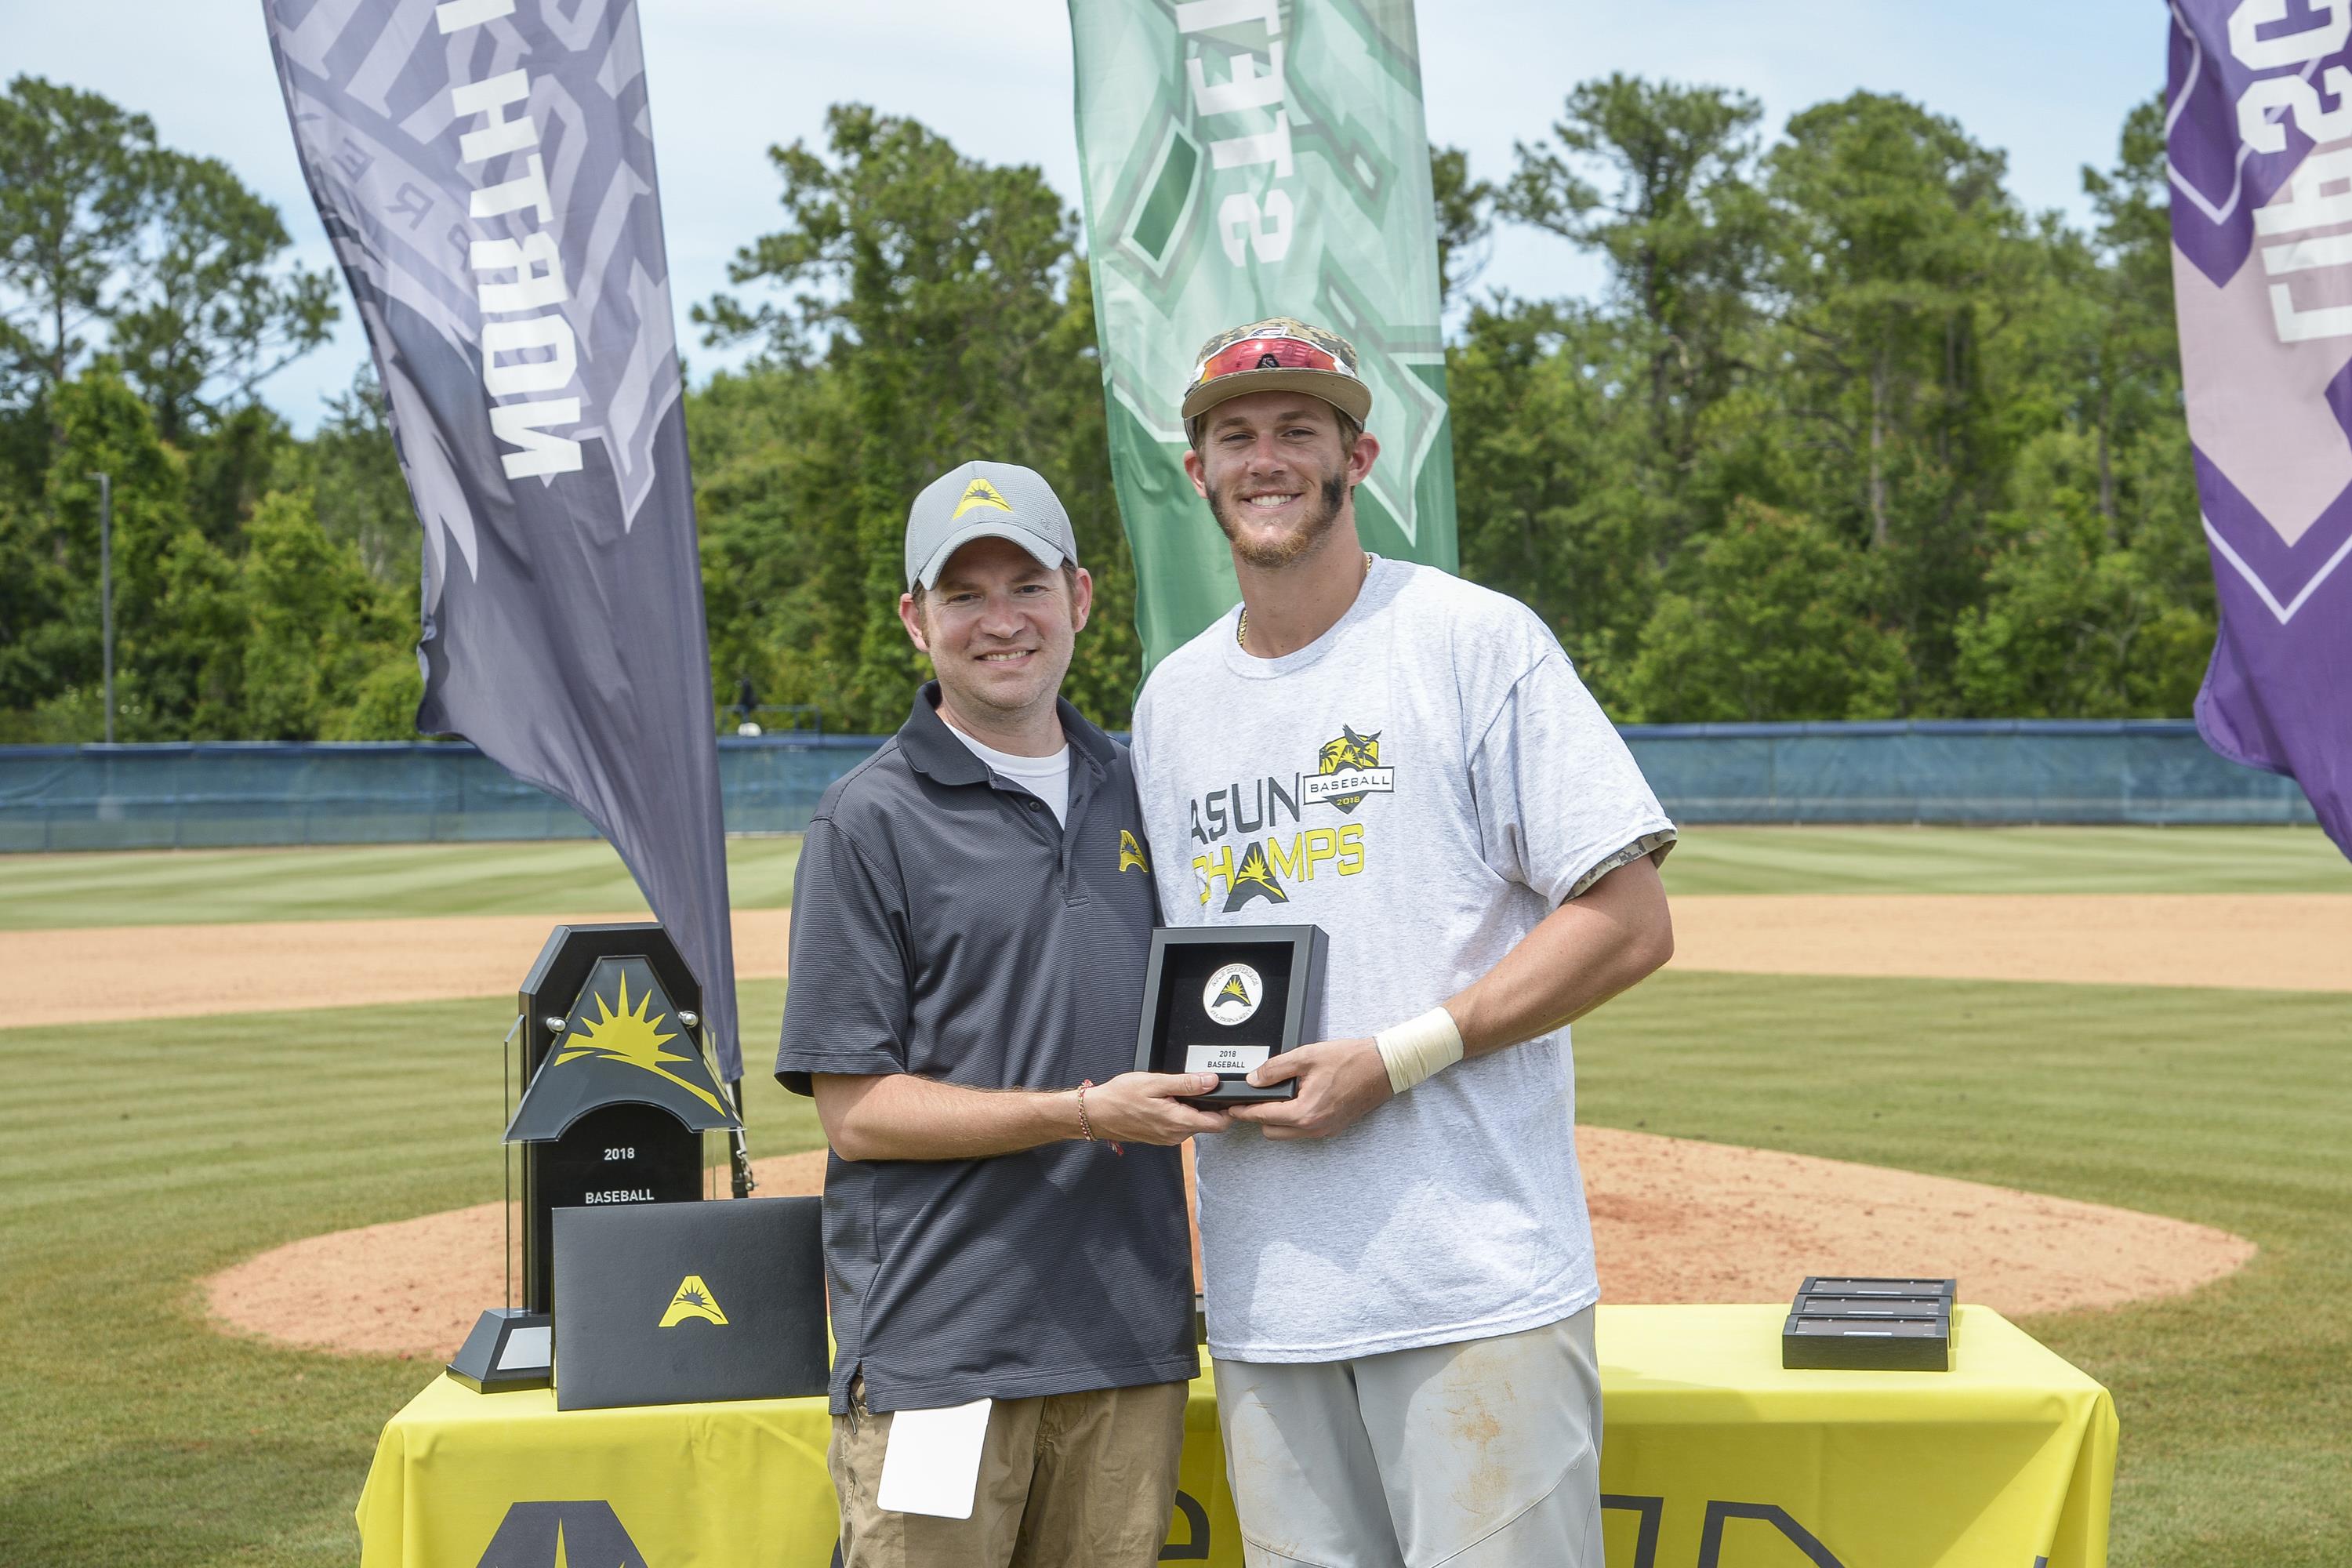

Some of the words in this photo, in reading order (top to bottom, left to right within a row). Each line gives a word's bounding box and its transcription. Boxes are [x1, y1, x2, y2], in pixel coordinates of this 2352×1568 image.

[1310, 775, 1390, 793] BASEBALL
[1191, 772, 1300, 845] ASUN
[1337, 796, 1360, 806] 2018
[604, 1147, 635, 1160] 2018
[585, 1189, 655, 1204] BASEBALL
